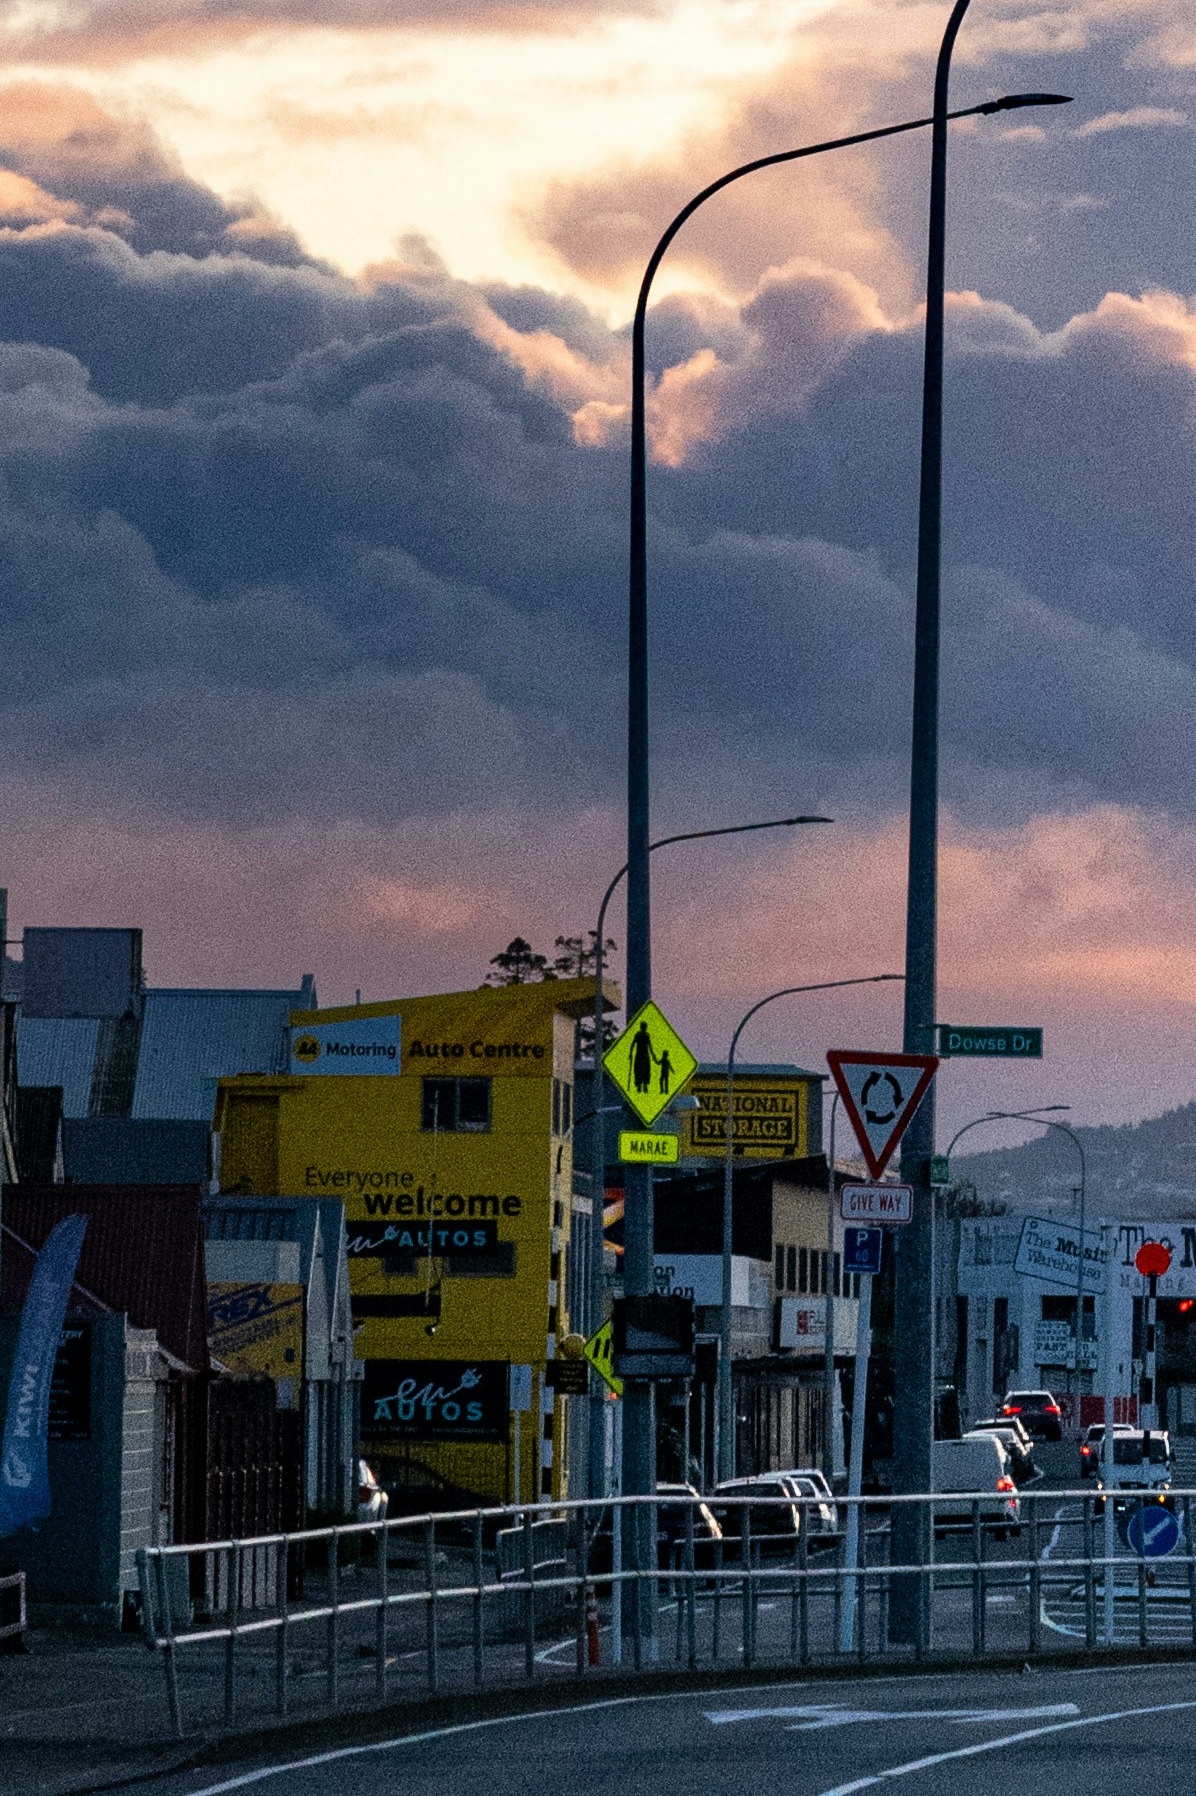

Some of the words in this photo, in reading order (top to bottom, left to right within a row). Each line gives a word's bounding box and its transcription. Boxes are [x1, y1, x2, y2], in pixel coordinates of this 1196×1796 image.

[326, 1042, 397, 1060] Motoring
[409, 1040, 464, 1058] Auto
[470, 1040, 545, 1058] Centre
[948, 1033, 1007, 1052] Dowse
[1012, 1034, 1032, 1052] Dr
[701, 1119, 789, 1137] STORAGE
[630, 1140, 669, 1155] MARAE
[305, 1166, 414, 1192] Everyone
[364, 1187, 521, 1216] welcome
[850, 1194, 875, 1212] GIVE
[879, 1194, 903, 1212] WAY
[398, 1230, 488, 1248] AUTOS
[856, 1230, 870, 1247] P
[1025, 1230, 1052, 1250] The
[13, 1363, 40, 1438] KIWI
[372, 1400, 484, 1422] AUTOS
